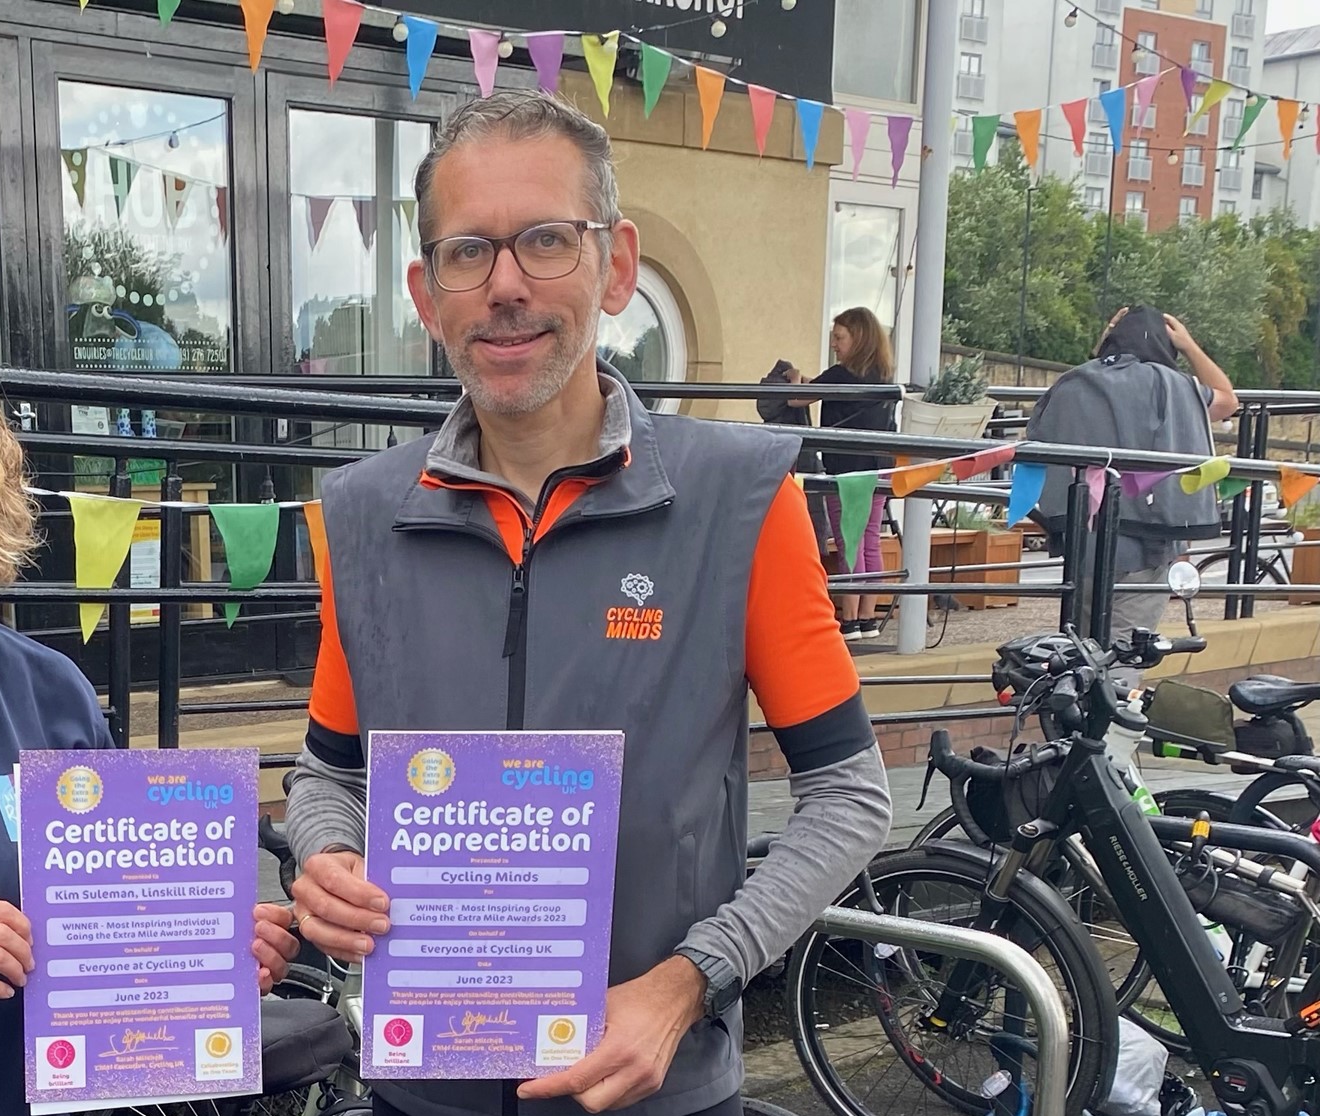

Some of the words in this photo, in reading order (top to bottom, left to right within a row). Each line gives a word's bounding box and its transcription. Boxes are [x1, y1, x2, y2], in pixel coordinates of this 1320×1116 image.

[606, 607, 664, 623] CYCLING
[606, 621, 663, 640] MINDS
[503, 760, 521, 768] we
[524, 760, 544, 768] are
[147, 775, 165, 784] we
[167, 775, 186, 784] are
[501, 766, 594, 790] cycling
[147, 781, 234, 806] cycling
[562, 786, 577, 794] UK
[204, 801, 218, 809] UK
[393, 800, 553, 826] Certificate
[561, 801, 595, 826] of
[45, 817, 198, 844] Certificate
[205, 816, 236, 840] of
[391, 827, 591, 856] Appreciation
[1109, 835, 1127, 862] RIESE
[45, 842, 234, 874] Appreciation
[441, 871, 492, 885] Cycling
[495, 871, 539, 883] Minds
[55, 890, 79, 900] Kim
[82, 888, 139, 900] Suleman,
[142, 886, 186, 897] Linskill
[189, 886, 226, 896] Riders
[415, 904, 453, 912] WINNER
[461, 904, 486, 912] Most
[487, 904, 530, 914] Inspiring
[533, 904, 561, 914] Group
[62, 922, 99, 930] WINNER
[106, 921, 130, 929] Most
[131, 920, 172, 929] Inspiring
[174, 918, 220, 927] Individual
[409, 914, 437, 924] Going
[439, 914, 455, 922] the
[457, 914, 481, 922] Extra
[483, 914, 505, 922] Mile
[507, 914, 542, 922] Awards
[544, 914, 566, 922] 2023
[66, 933, 94, 941] Going
[96, 931, 111, 939] the
[113, 931, 136, 939] Extra
[137, 929, 158, 938] Mile
[160, 929, 193, 937] Awards
[194, 928, 216, 936] 2023
[420, 945, 474, 956] Everyone
[476, 945, 488, 954] at
[490, 945, 533, 956] Cycling
[535, 945, 552, 954] UK
[79, 963, 130, 973] Everyone
[132, 961, 143, 970] at
[145, 960, 186, 971] Cycling
[188, 958, 204, 968] UK
[456, 976, 483, 985] June
[485, 976, 513, 984] 2023
[114, 992, 140, 1003] June
[143, 991, 169, 1001] 2023
